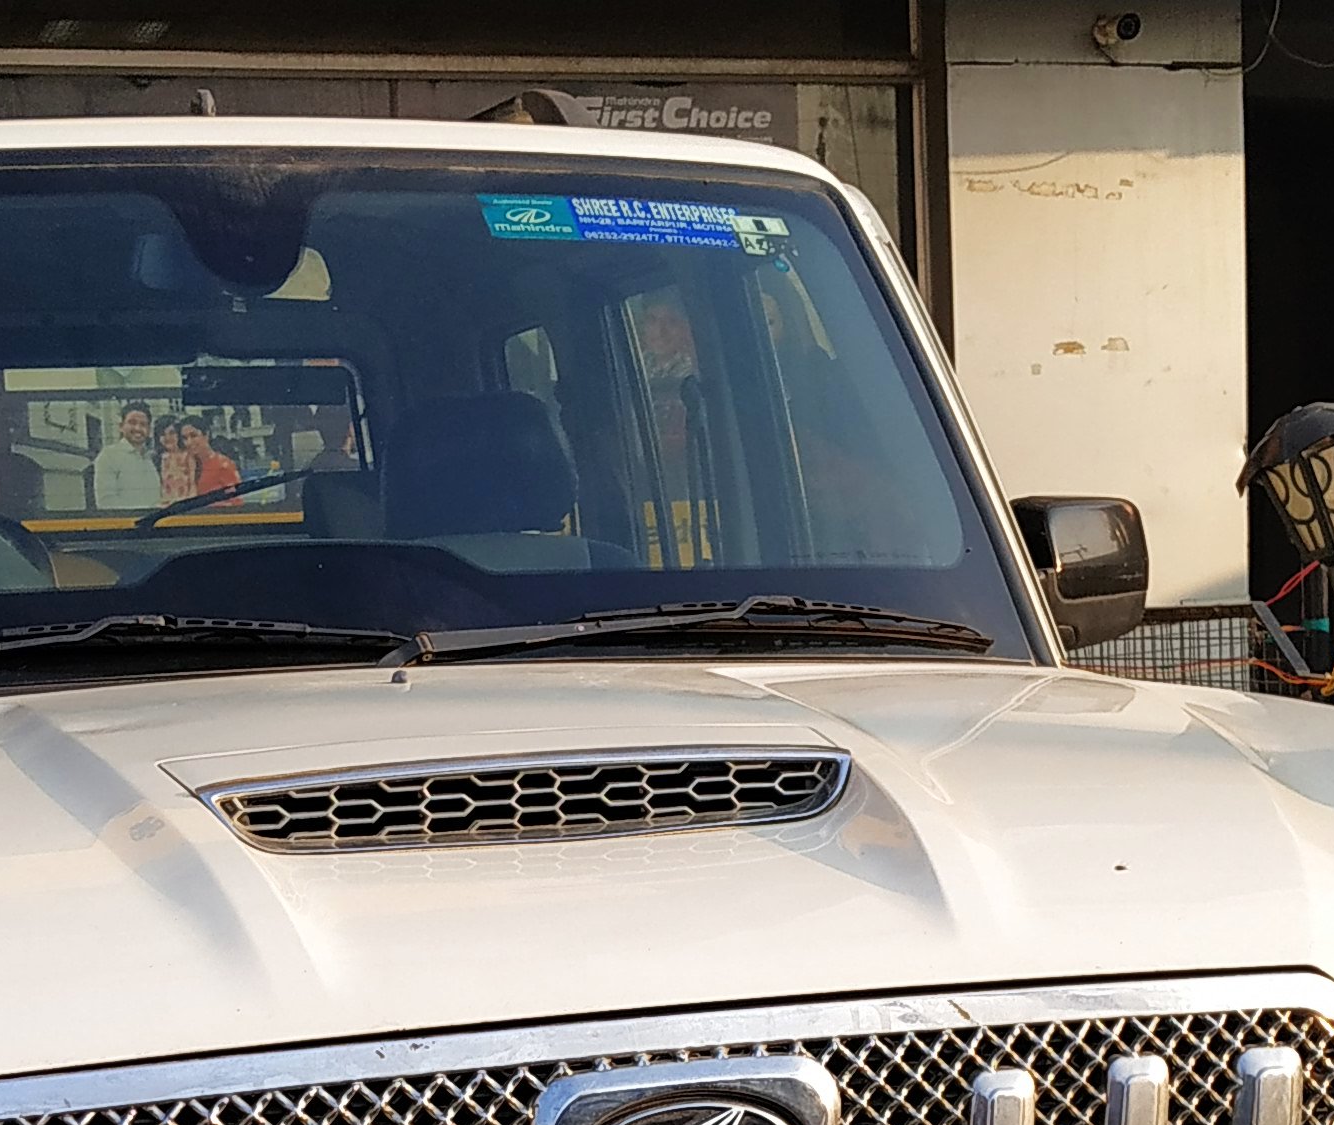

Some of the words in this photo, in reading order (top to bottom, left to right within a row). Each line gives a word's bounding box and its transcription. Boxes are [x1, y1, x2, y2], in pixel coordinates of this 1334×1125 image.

[662, 96, 772, 129] Choice
[571, 197, 621, 217] SHREE
[618, 199, 652, 219] R.C.
[647, 201, 737, 225] ENTERPRISES
